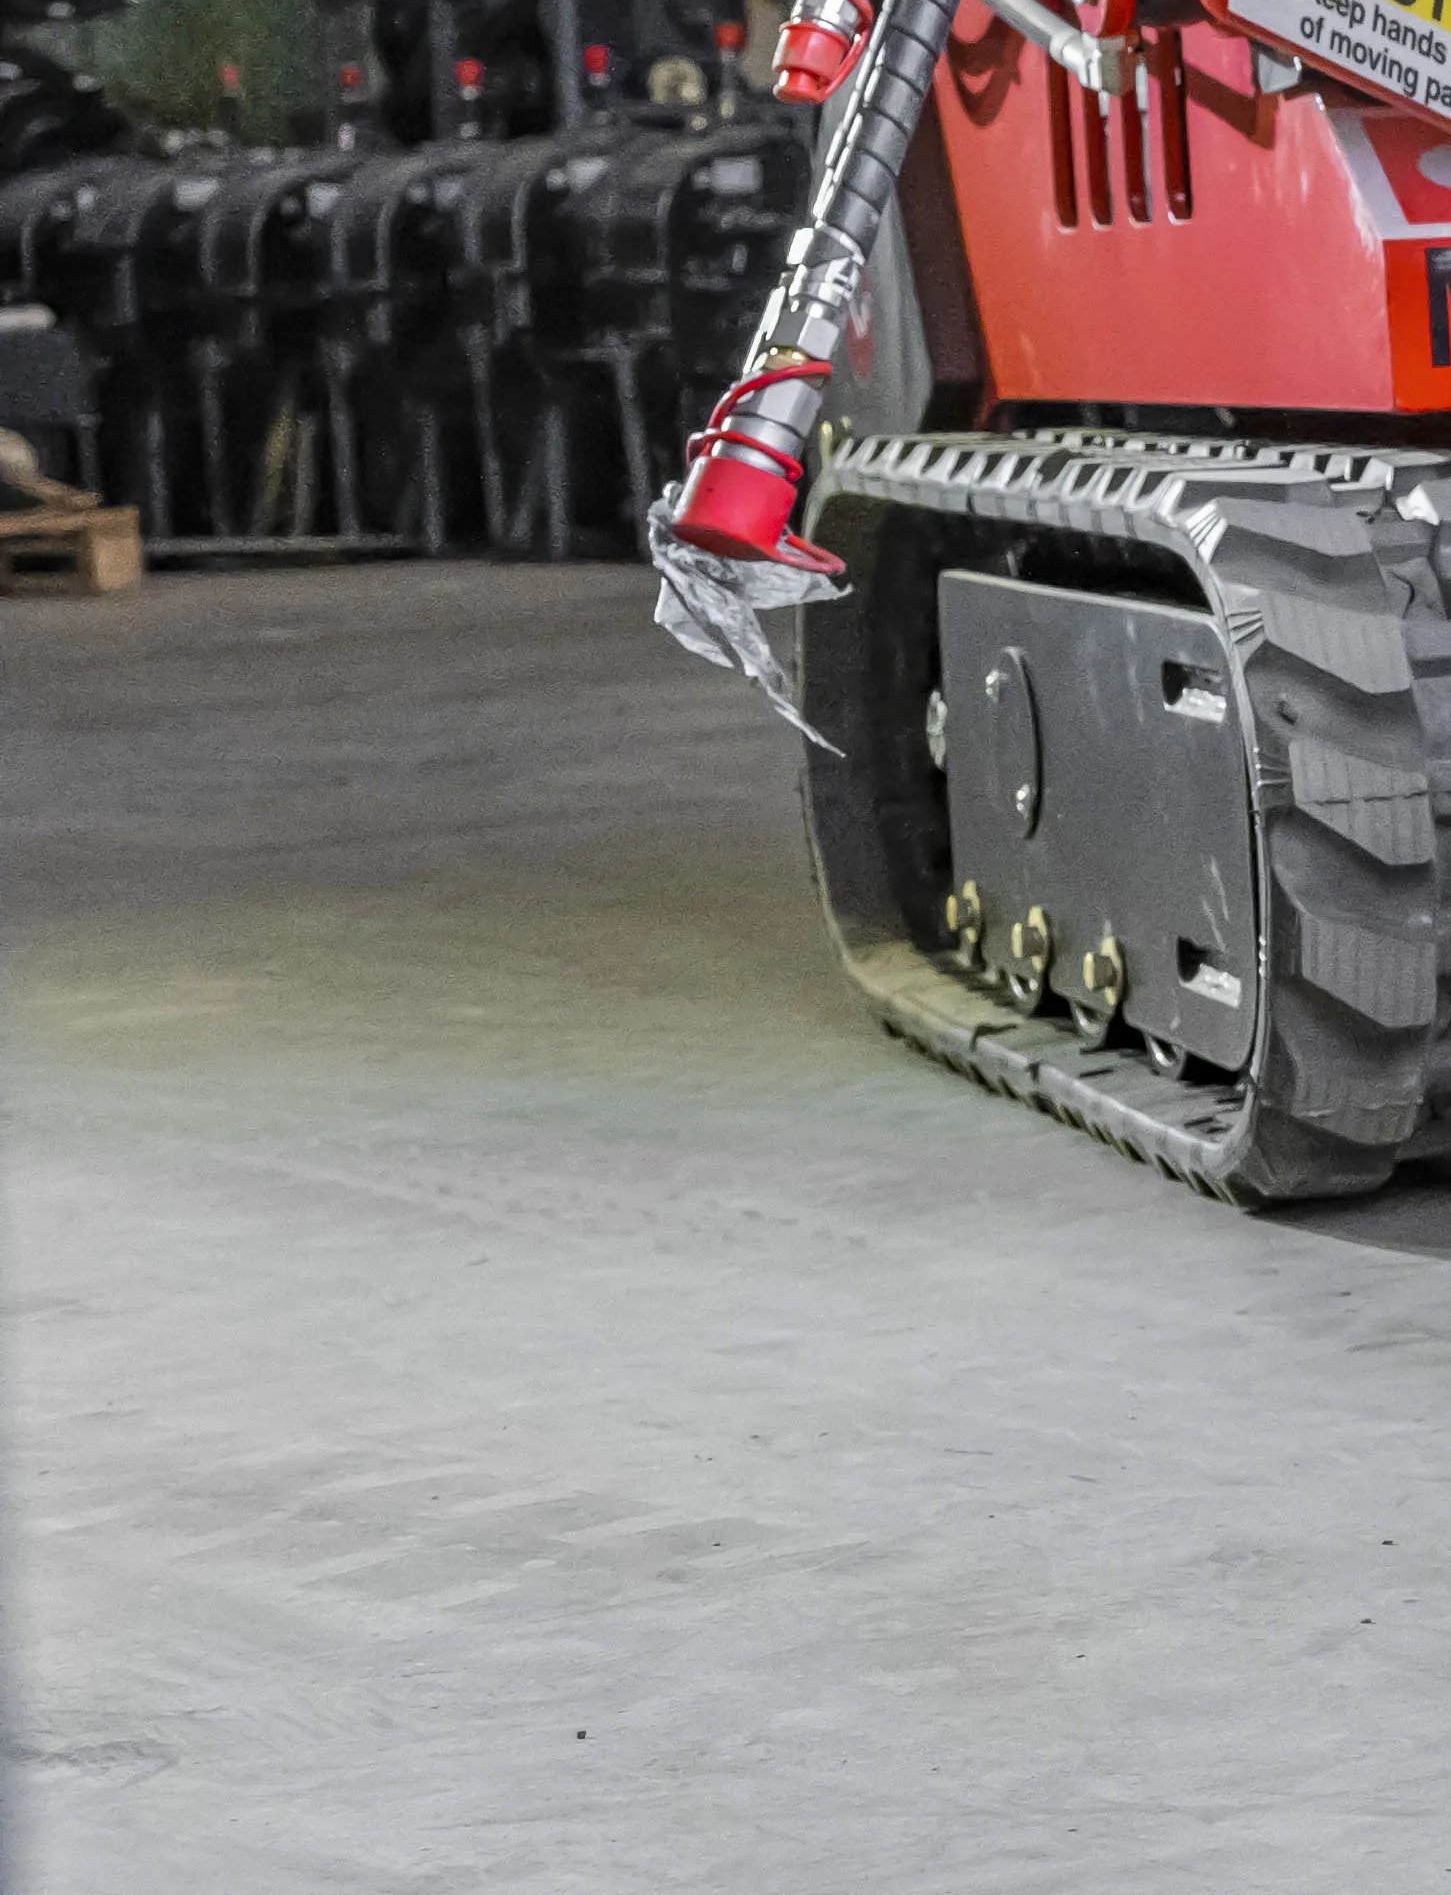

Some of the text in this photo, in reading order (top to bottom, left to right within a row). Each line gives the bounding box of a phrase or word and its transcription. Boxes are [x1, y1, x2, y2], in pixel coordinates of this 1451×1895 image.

[1300, 15, 1326, 44] of
[1329, 26, 1420, 98] moving
[1373, 10, 1447, 65] hands
